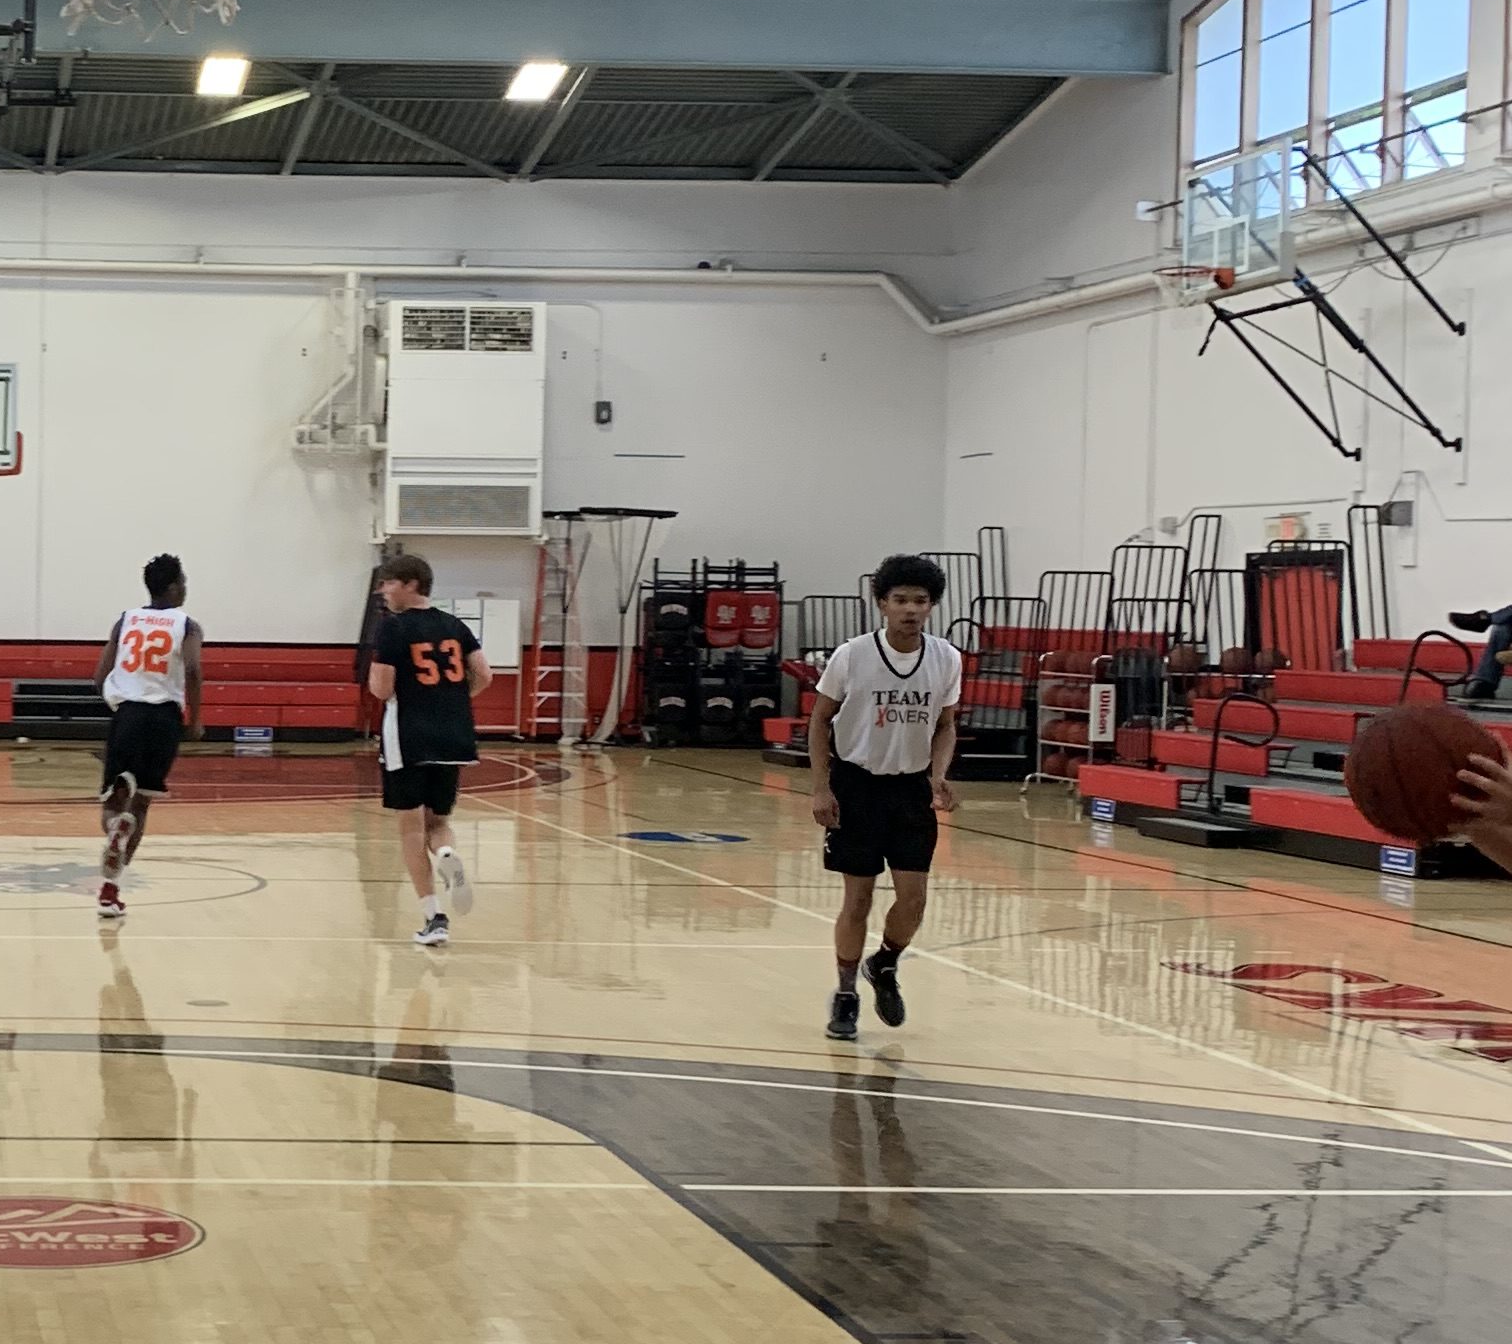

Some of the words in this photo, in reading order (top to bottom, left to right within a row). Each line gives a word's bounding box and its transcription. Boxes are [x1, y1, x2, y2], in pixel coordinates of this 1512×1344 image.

[120, 629, 173, 674] 32
[409, 639, 465, 685] 53
[871, 689, 931, 706] TEAM
[1098, 689, 1112, 735] Wilson
